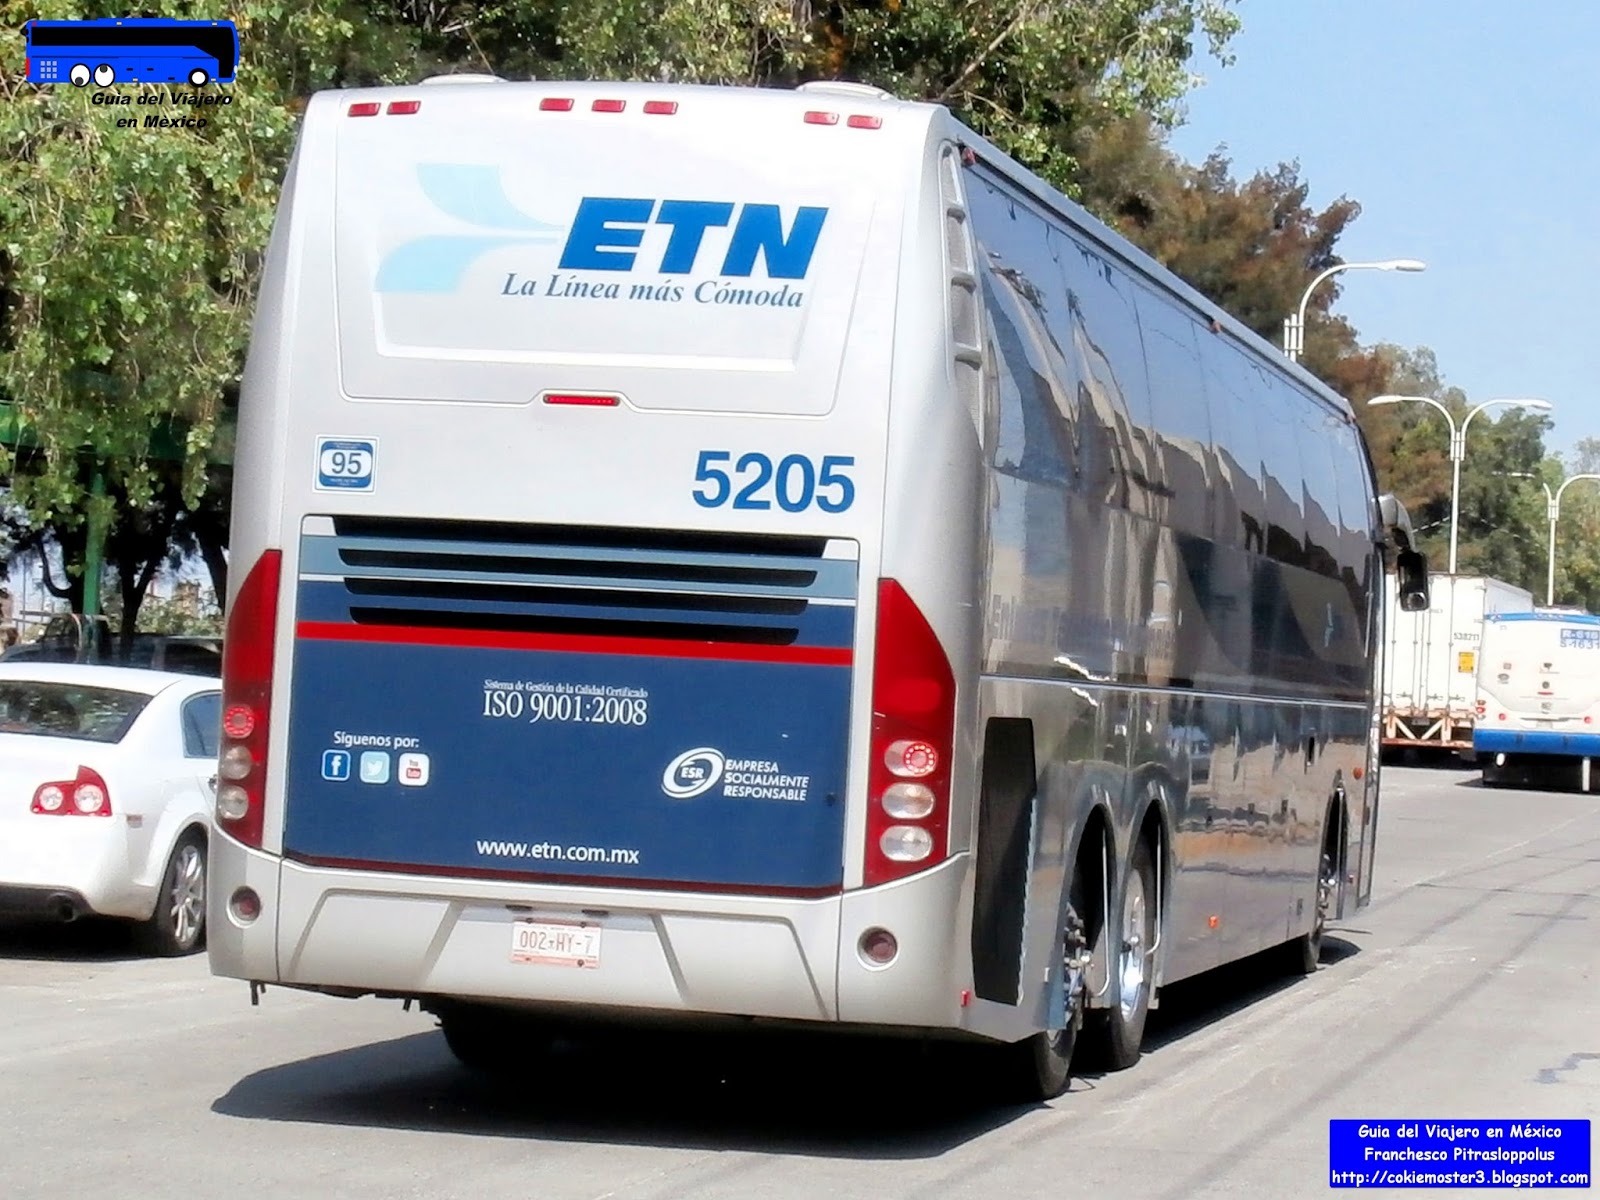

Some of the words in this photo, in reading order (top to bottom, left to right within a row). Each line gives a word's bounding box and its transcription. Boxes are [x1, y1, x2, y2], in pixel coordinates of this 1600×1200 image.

[557, 197, 829, 280] ETN
[501, 273, 537, 297] La
[545, 274, 620, 300] Línea
[628, 279, 684, 303] más
[694, 280, 805, 309] Cómoda
[331, 451, 362, 475] 95
[692, 450, 855, 514] 5205
[483, 679, 514, 691] Sistema
[515, 681, 525, 692] de
[526, 682, 554, 693] Gestión
[556, 683, 566, 694] de
[575, 685, 605, 696] Calidad
[483, 690, 524, 719] ISO
[529, 693, 648, 727] 9001:2008
[334, 731, 392, 748] Síguenos
[393, 738, 420, 750] por:
[681, 767, 705, 779] ESR
[725, 759, 779, 773] EMPRESA
[724, 772, 810, 788] SOCIALMENTE
[723, 785, 807, 801] RESPONSABLE
[476, 840, 640, 865] www.etn.com.mx
